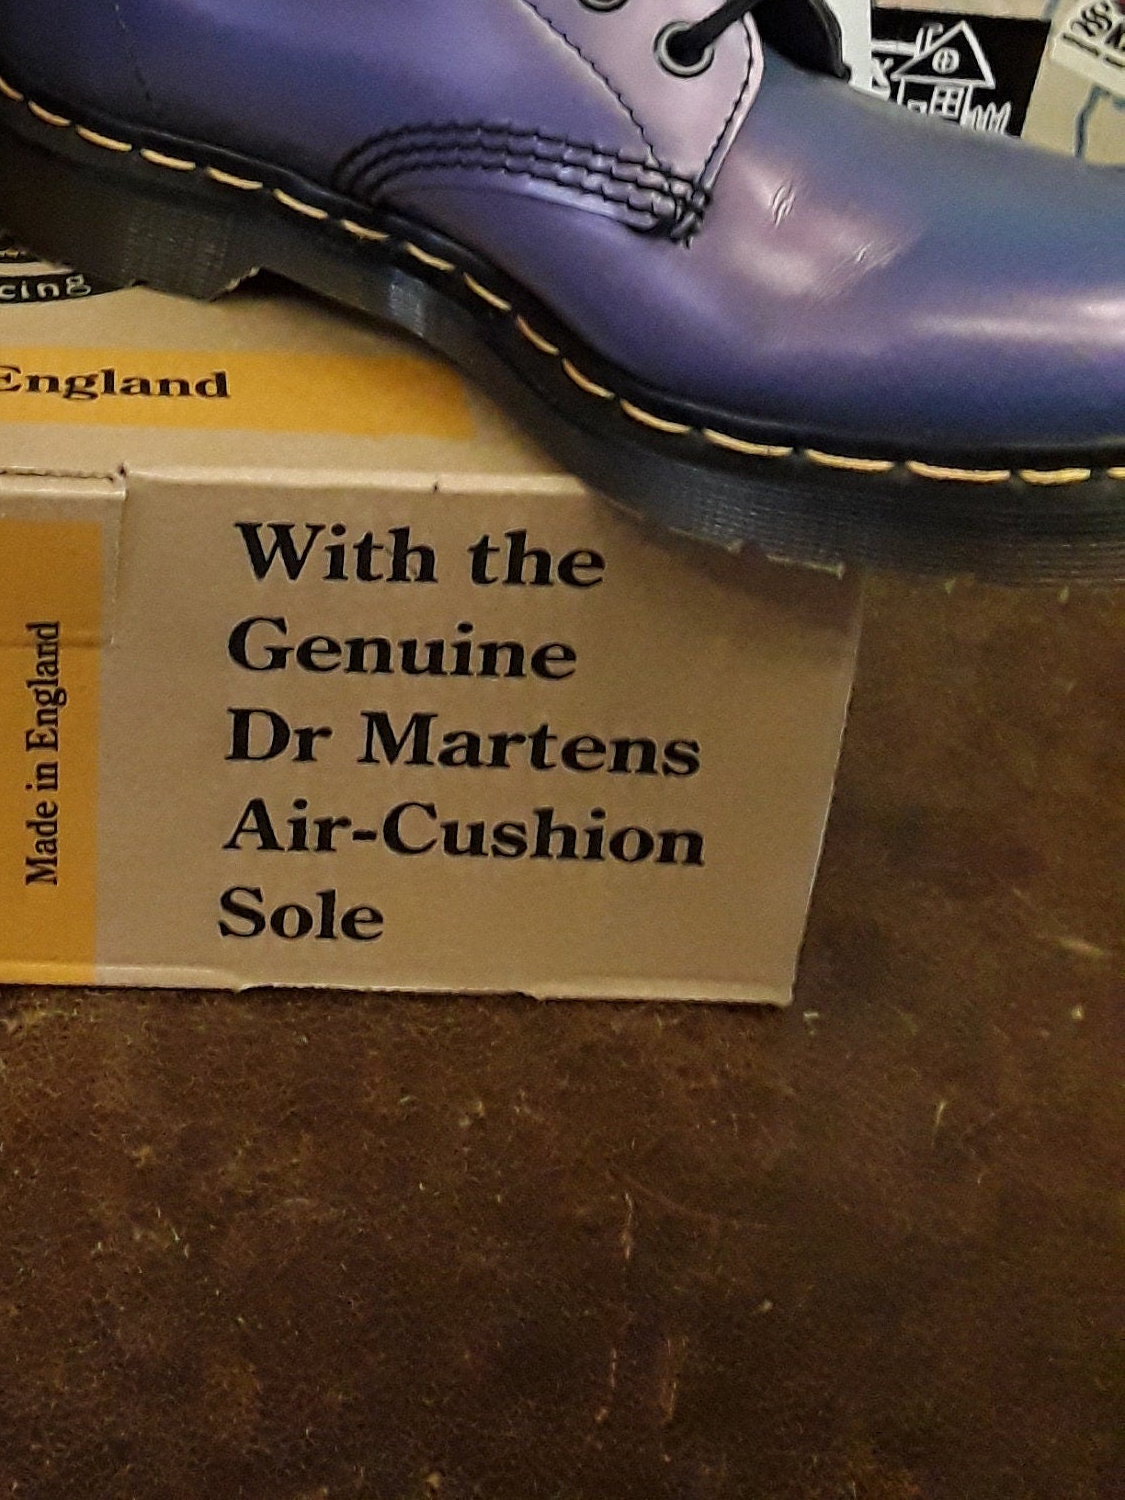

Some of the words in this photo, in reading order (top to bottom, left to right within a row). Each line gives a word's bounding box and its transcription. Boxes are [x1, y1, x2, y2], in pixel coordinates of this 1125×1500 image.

[235, 521, 437, 584] With
[467, 528, 607, 589] the
[227, 616, 579, 681] Genuine
[24, 619, 68, 753] England
[226, 706, 333, 763] Dr
[357, 710, 702, 780] Martens
[26, 760, 59, 796] in
[24, 800, 59, 887] Made
[221, 797, 706, 868] Air-Cushion
[217, 884, 386, 944] Sole
